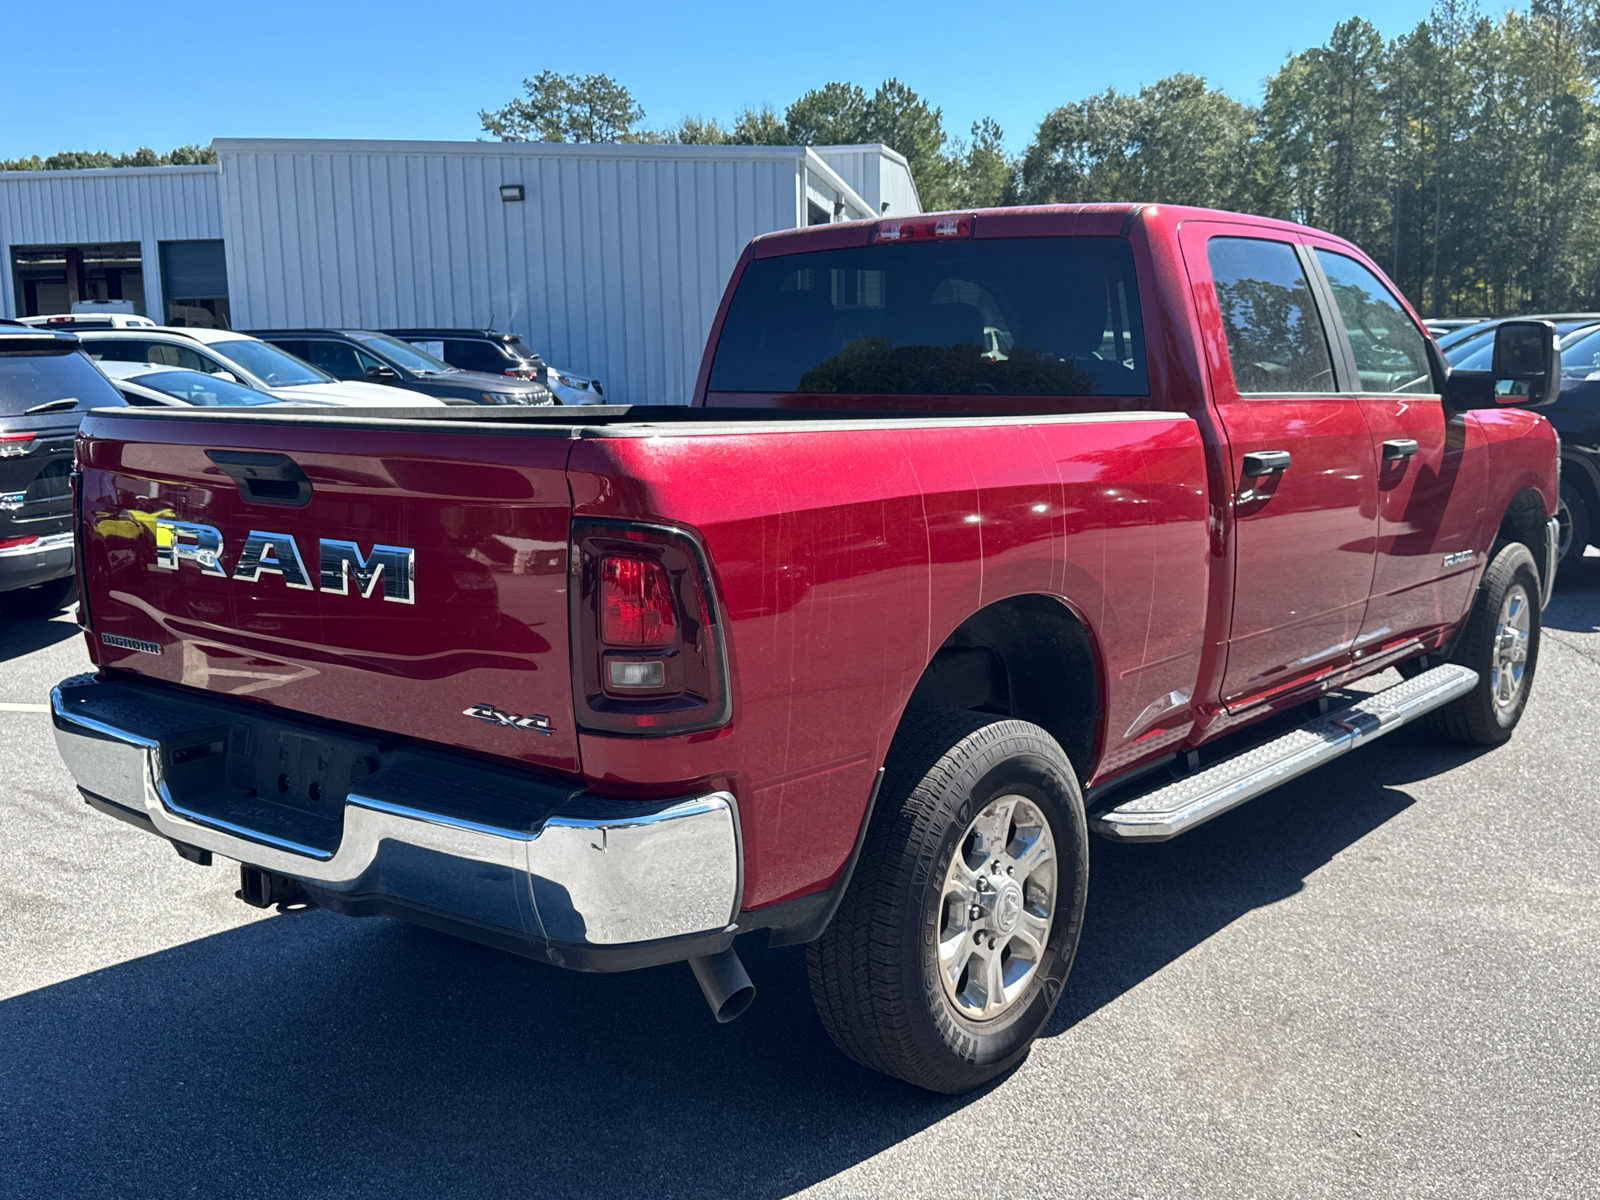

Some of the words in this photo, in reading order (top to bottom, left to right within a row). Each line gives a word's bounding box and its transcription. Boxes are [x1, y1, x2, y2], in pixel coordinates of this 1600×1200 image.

[156, 519, 415, 604] RAM
[102, 633, 161, 656] BIGHORN
[924, 909, 979, 1064] TRANSFORCE
